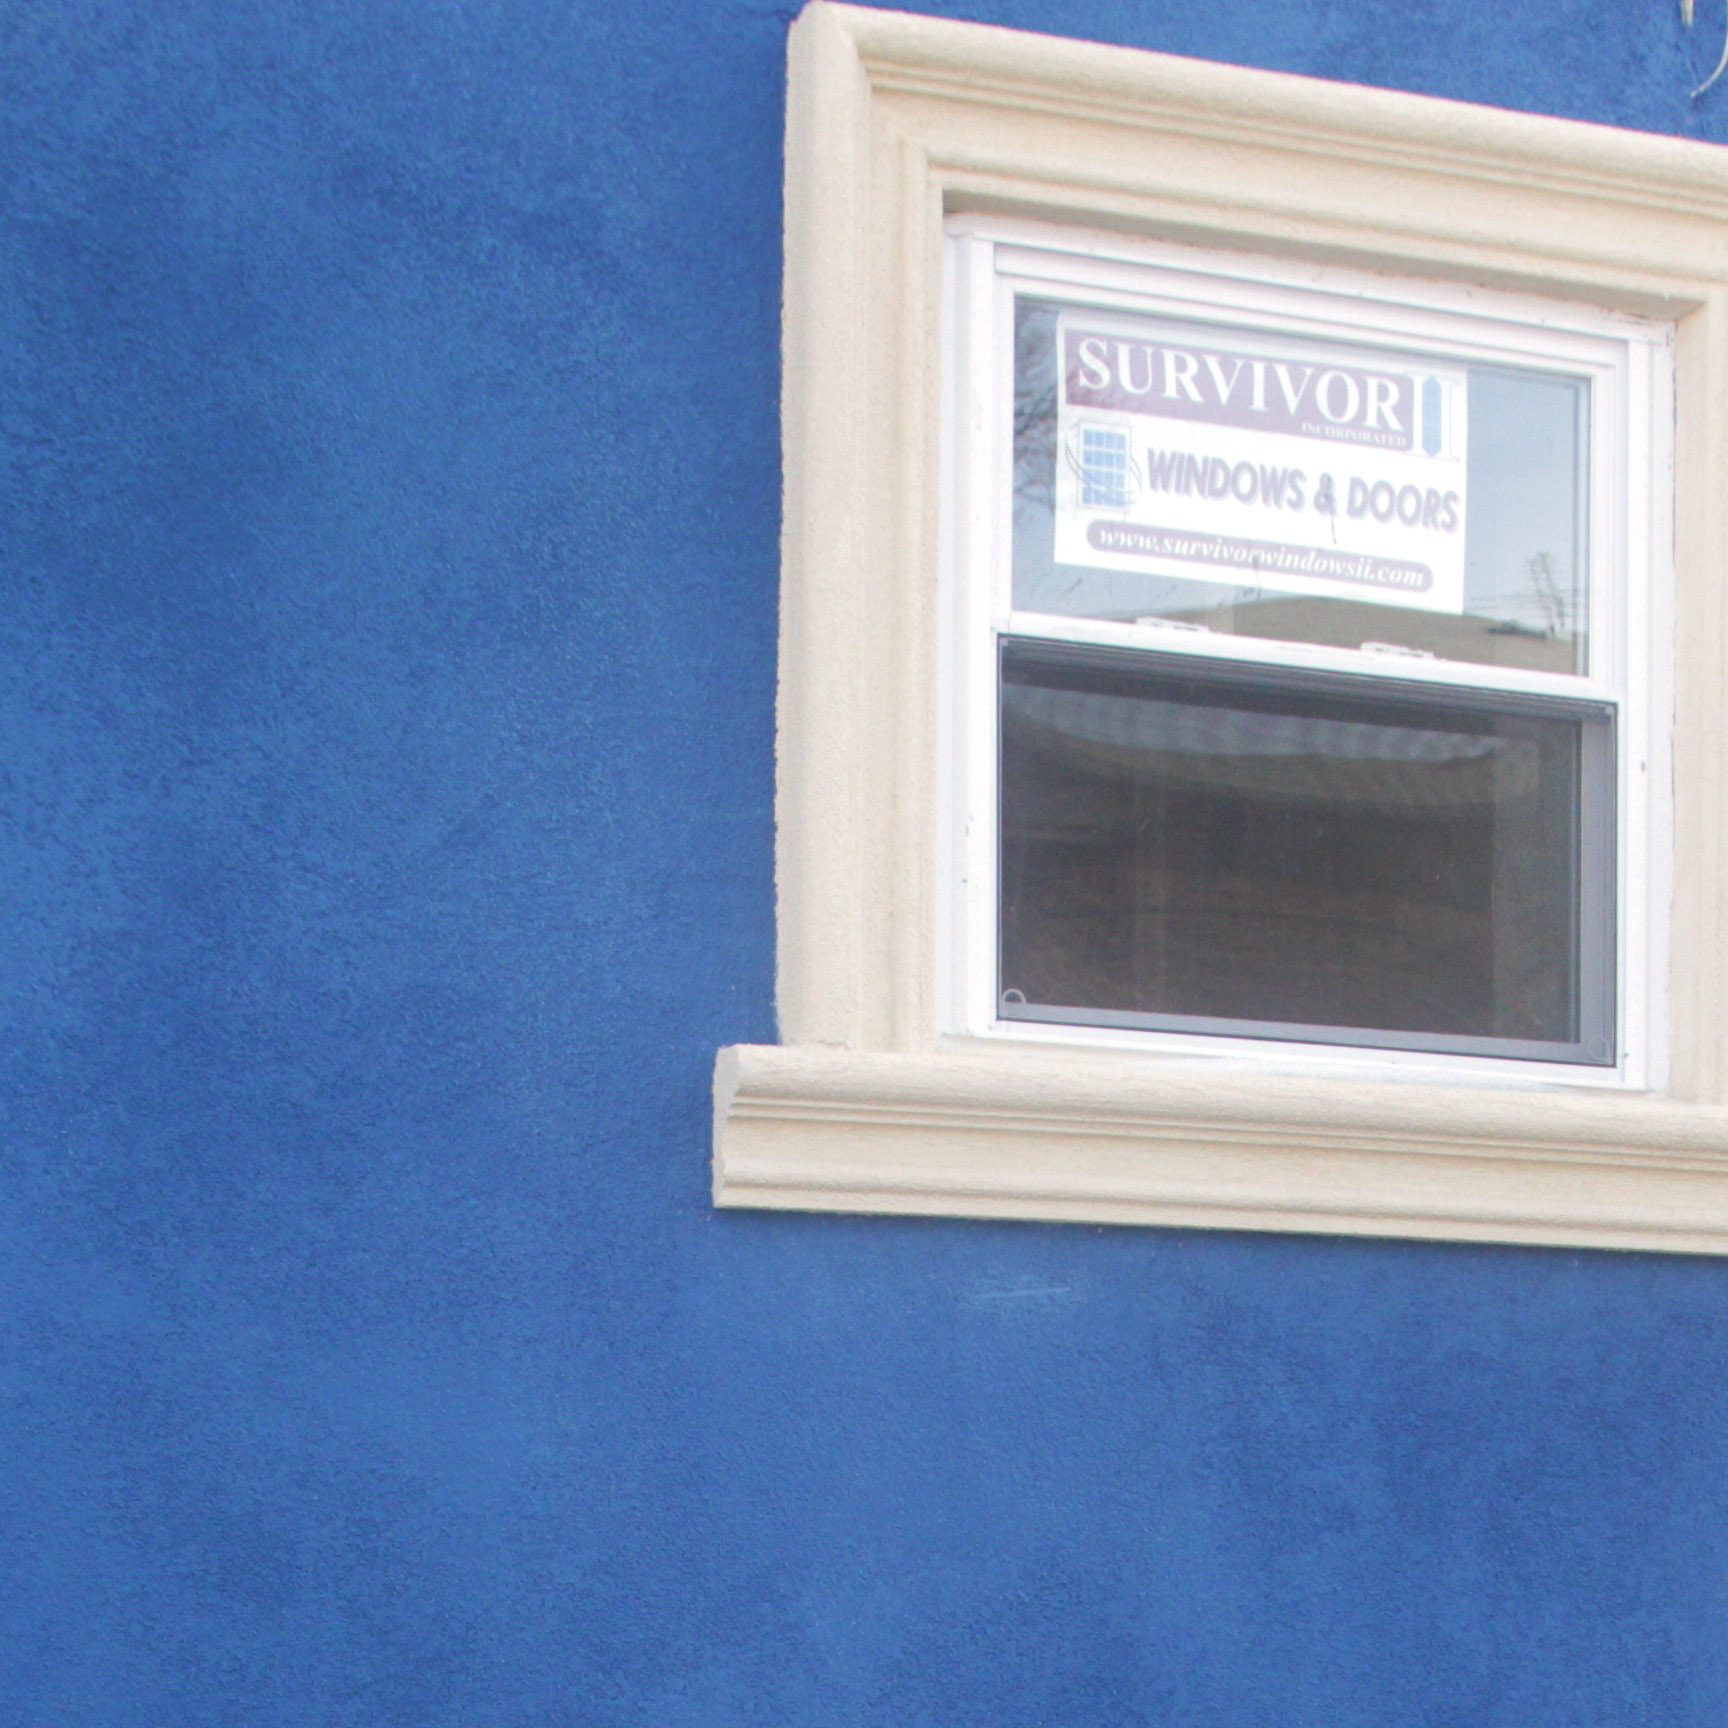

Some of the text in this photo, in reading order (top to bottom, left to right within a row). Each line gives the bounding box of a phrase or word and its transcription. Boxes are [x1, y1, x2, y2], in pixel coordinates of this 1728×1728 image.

[1078, 337, 1405, 431] SURVIVOR
[1301, 421, 1407, 448] INCORPORATED
[1146, 446, 1462, 534] WINDOWS & DOORS
[1098, 525, 1425, 587] www.survivorwindowsii.com
